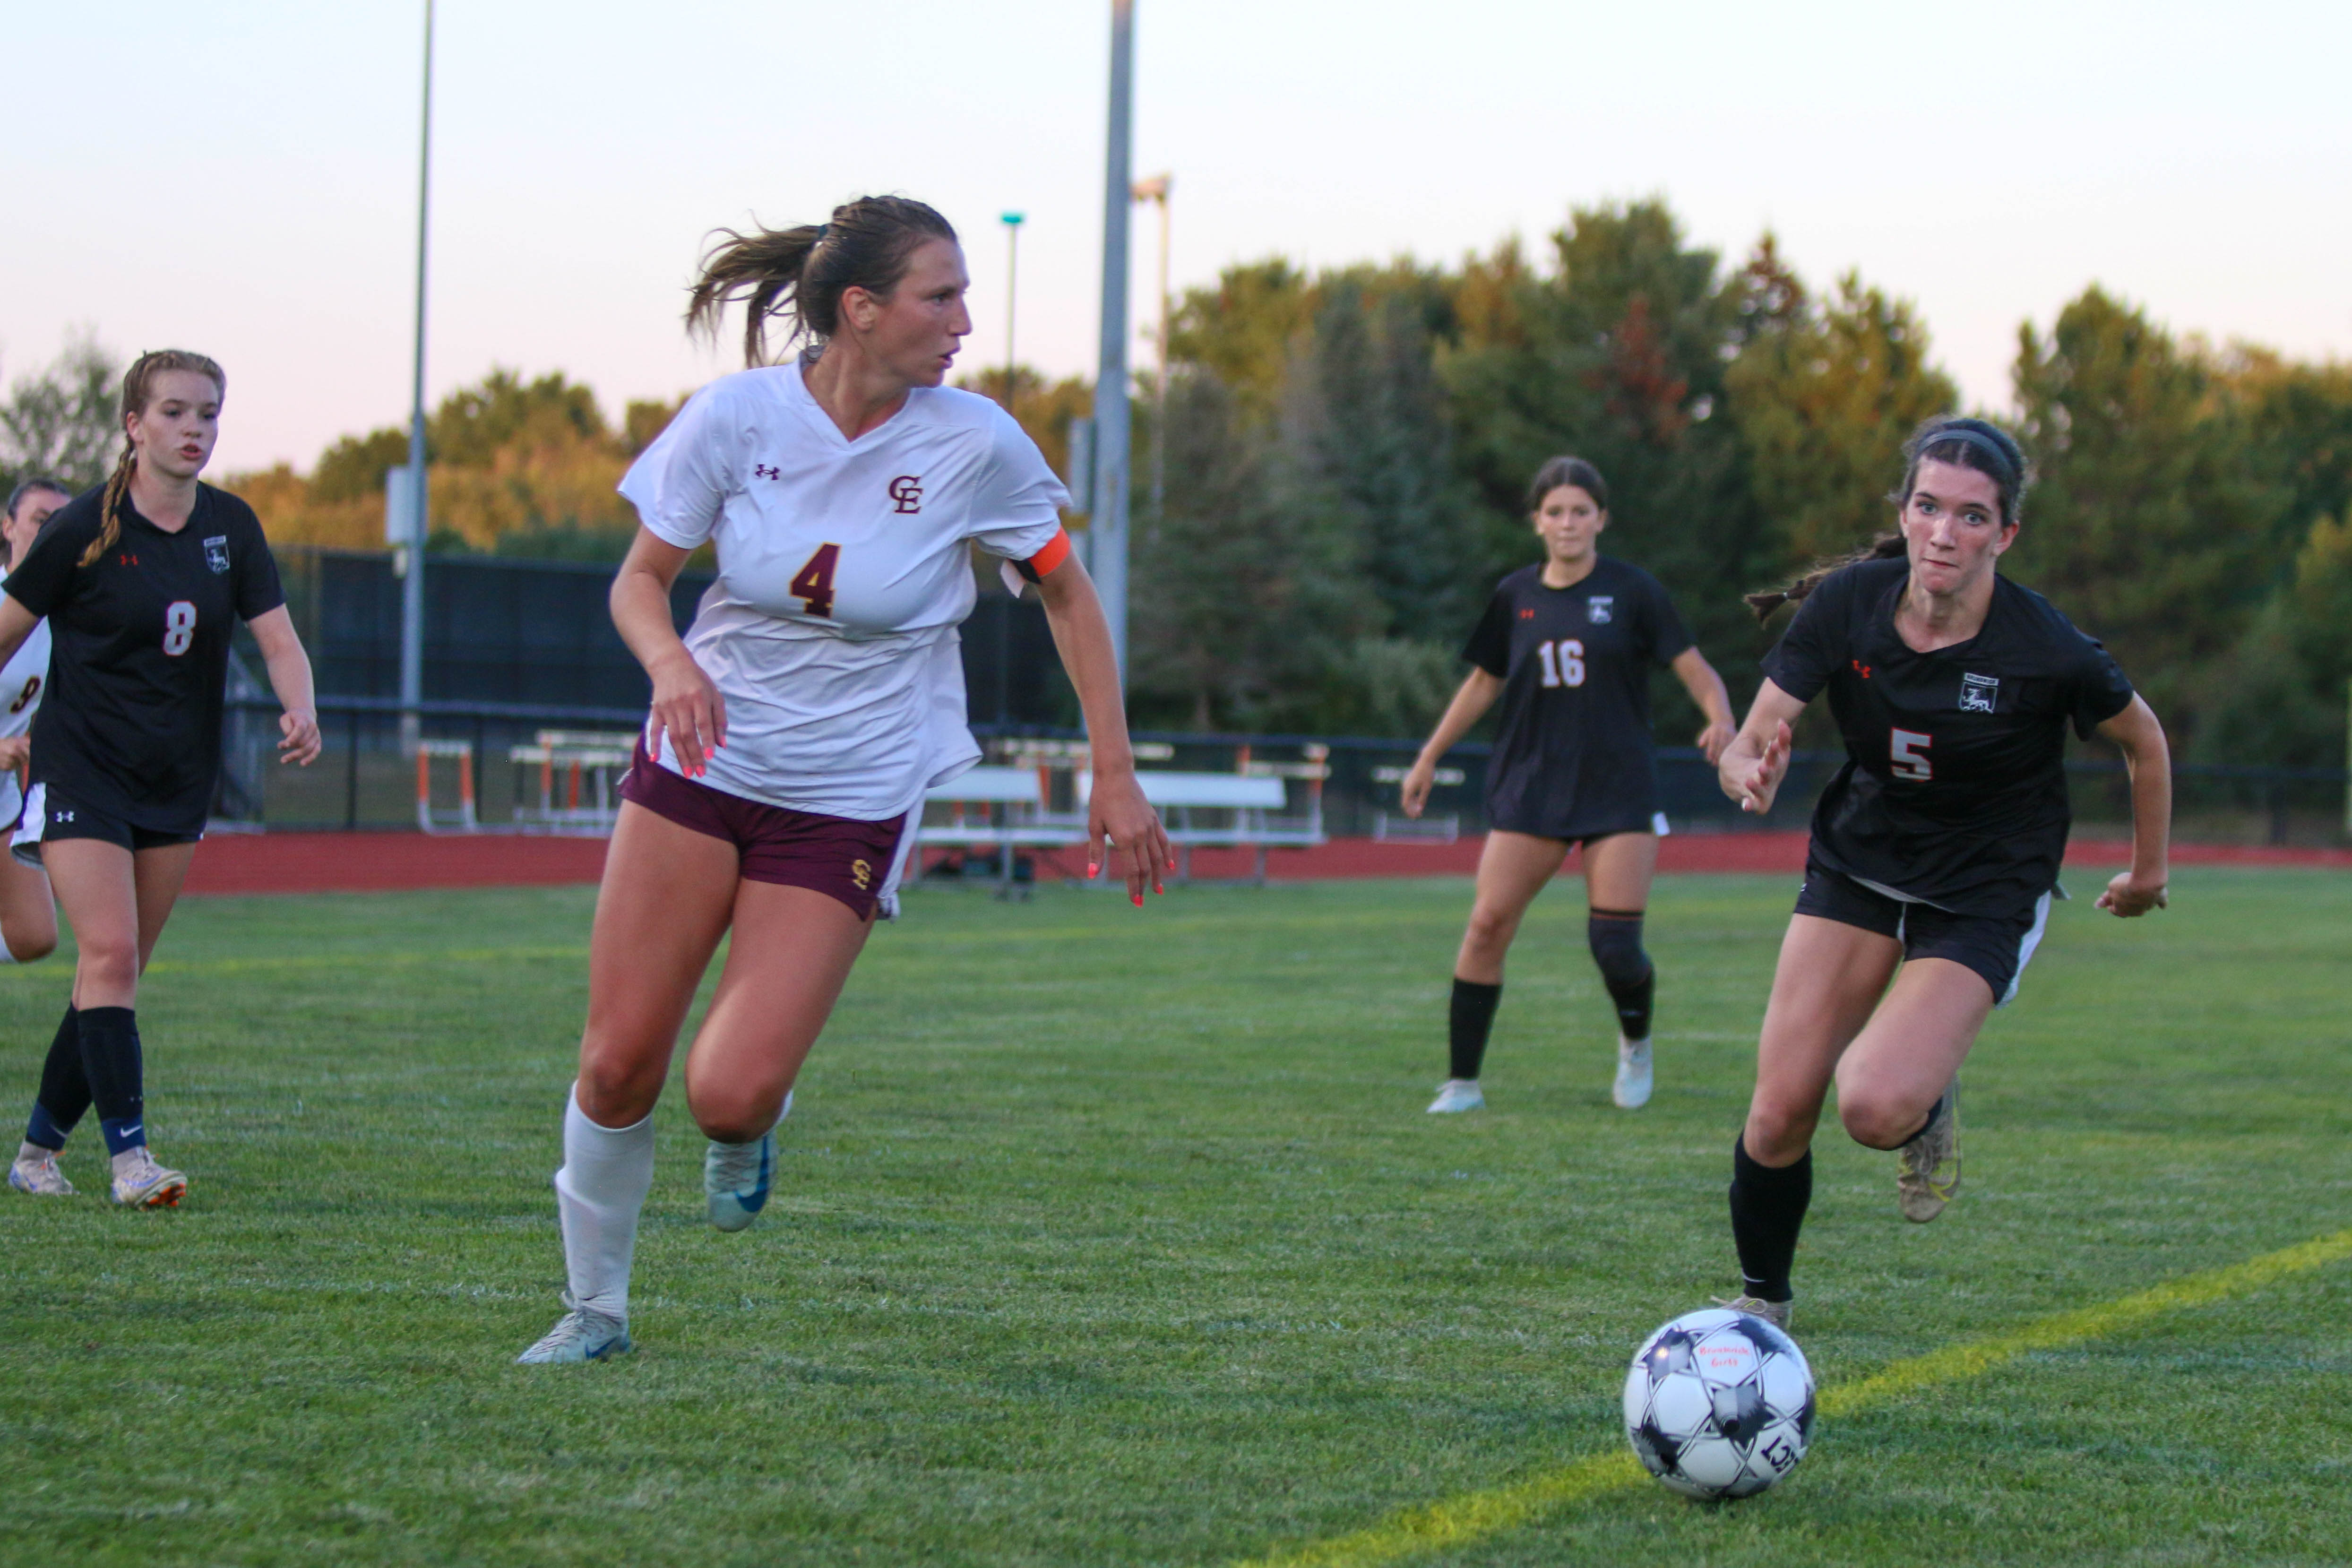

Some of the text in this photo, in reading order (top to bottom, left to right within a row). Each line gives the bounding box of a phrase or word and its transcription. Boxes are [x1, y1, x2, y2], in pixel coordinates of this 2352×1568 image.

[789, 542, 841, 619] 4
[163, 600, 197, 656] 8
[1537, 638, 1586, 688] 16
[9, 674, 41, 715] 9
[1890, 726, 1934, 782] 5
